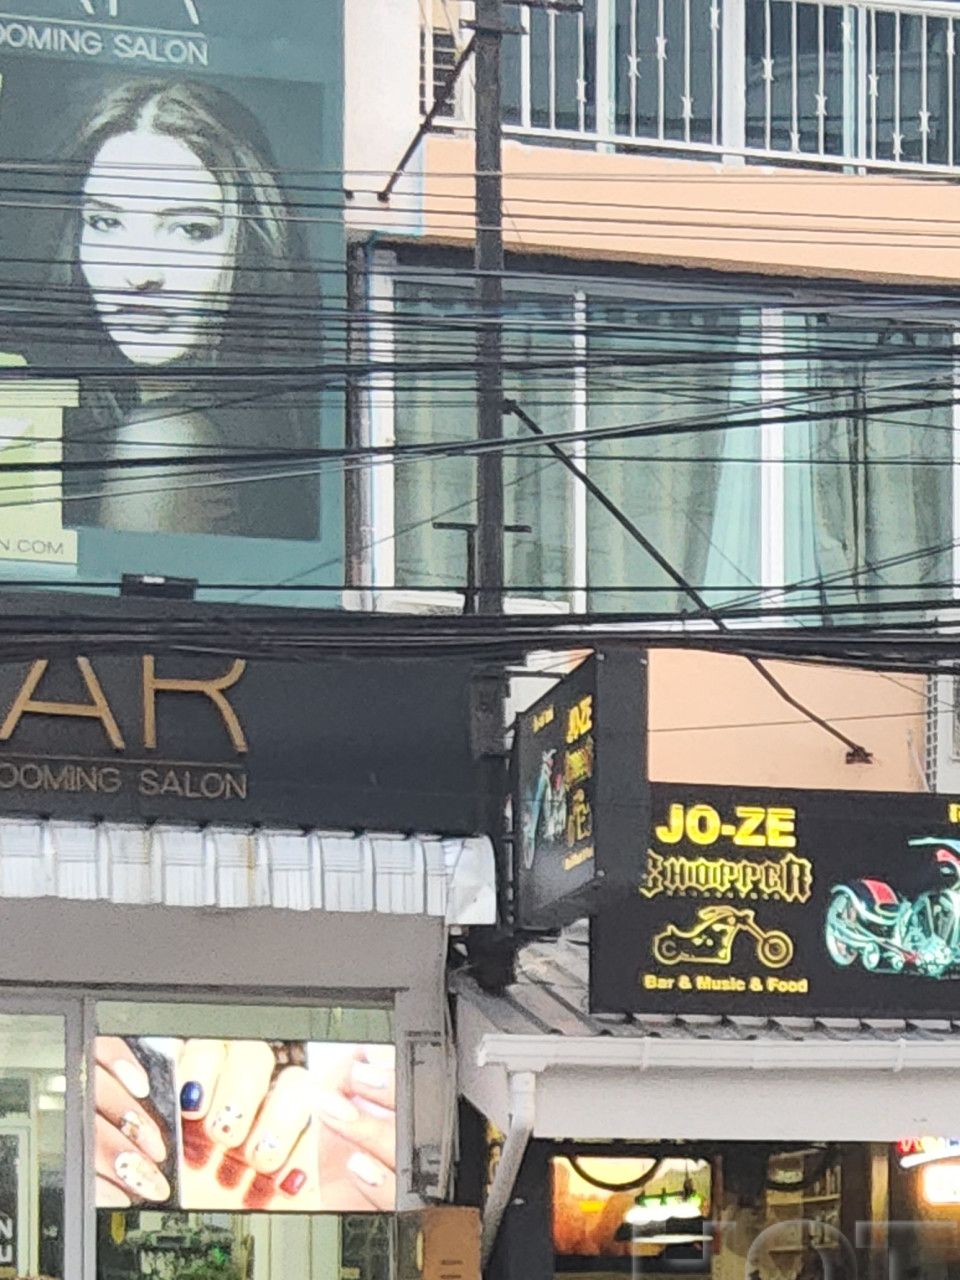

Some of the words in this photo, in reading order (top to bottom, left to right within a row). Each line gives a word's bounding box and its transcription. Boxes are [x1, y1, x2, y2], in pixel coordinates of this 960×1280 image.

[113, 33, 209, 66] SALON
[139, 769, 247, 799] SALON
[655, 803, 797, 847] JO-ZE
[643, 974, 675, 990] Bar
[678, 974, 692, 990] &
[696, 975, 746, 992] Music
[750, 976, 763, 992] &
[767, 976, 808, 993] Food
